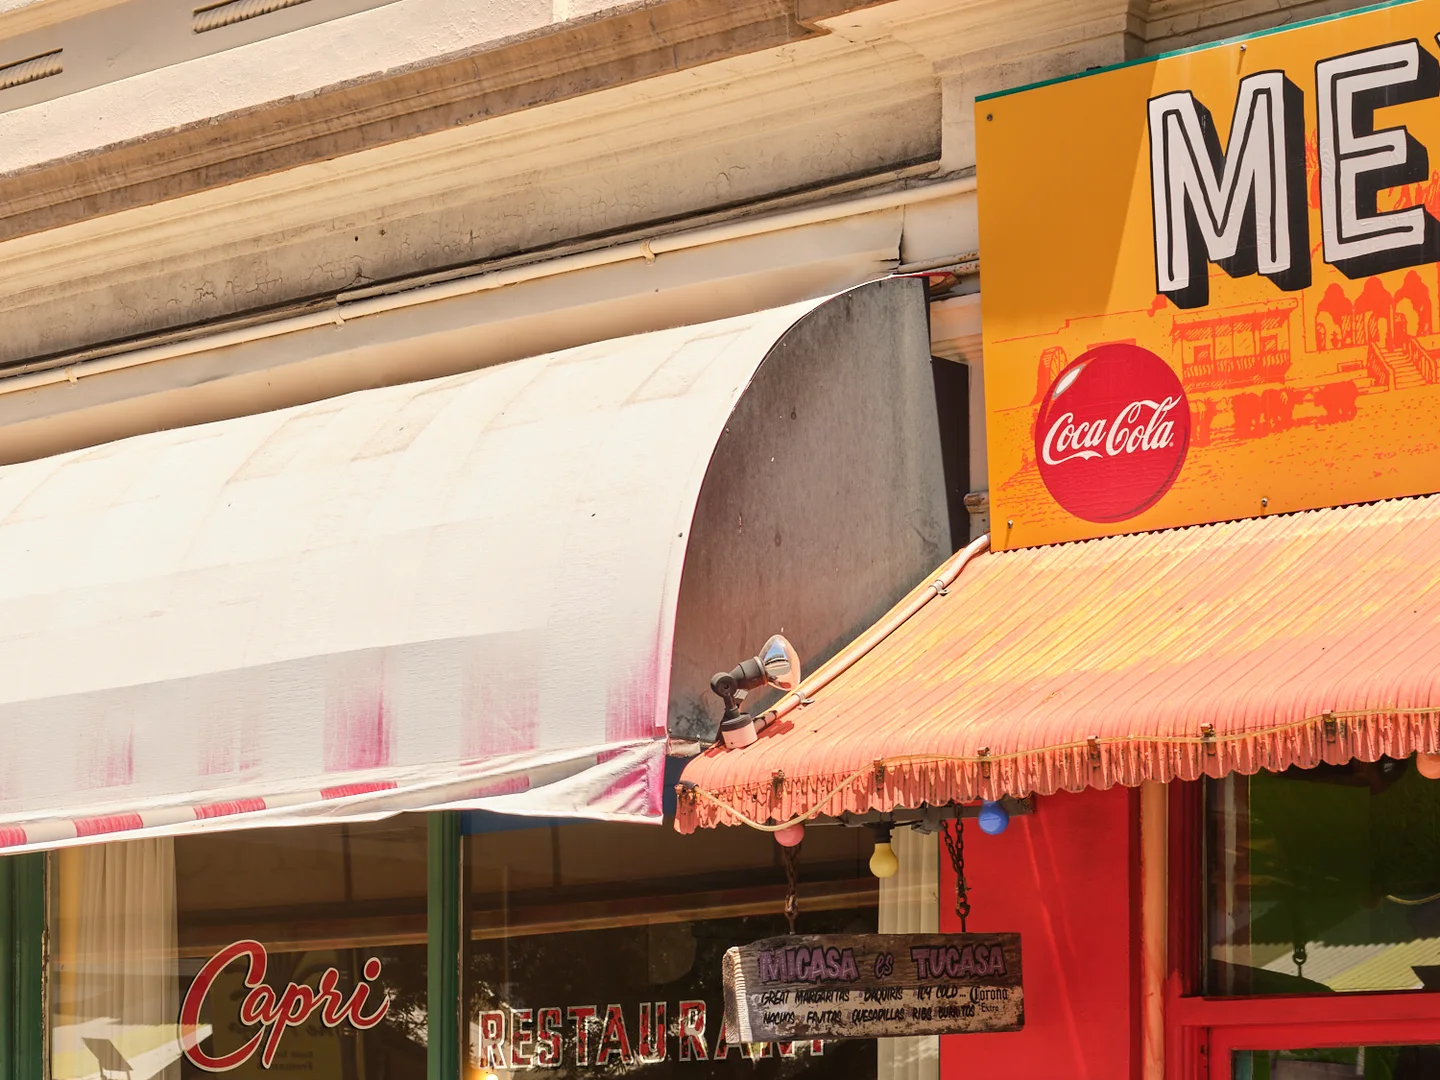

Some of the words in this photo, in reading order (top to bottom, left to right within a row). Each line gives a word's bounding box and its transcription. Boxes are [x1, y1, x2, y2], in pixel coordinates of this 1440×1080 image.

[1147, 32, 1440, 310] ME
[758, 946, 860, 985] MICASA
[874, 950, 894, 979] es
[910, 943, 1008, 981] TUCASA
[179, 939, 390, 1073] Capri
[761, 990, 790, 1005] GREAT
[794, 988, 850, 1007] MARGARITAS
[970, 985, 1008, 1004] Corona
[763, 1011, 795, 1025] NACHOS
[806, 1009, 843, 1025] FAJITAS
[852, 1007, 905, 1024] QUESADILLAS
[911, 1006, 933, 1020] RIBS
